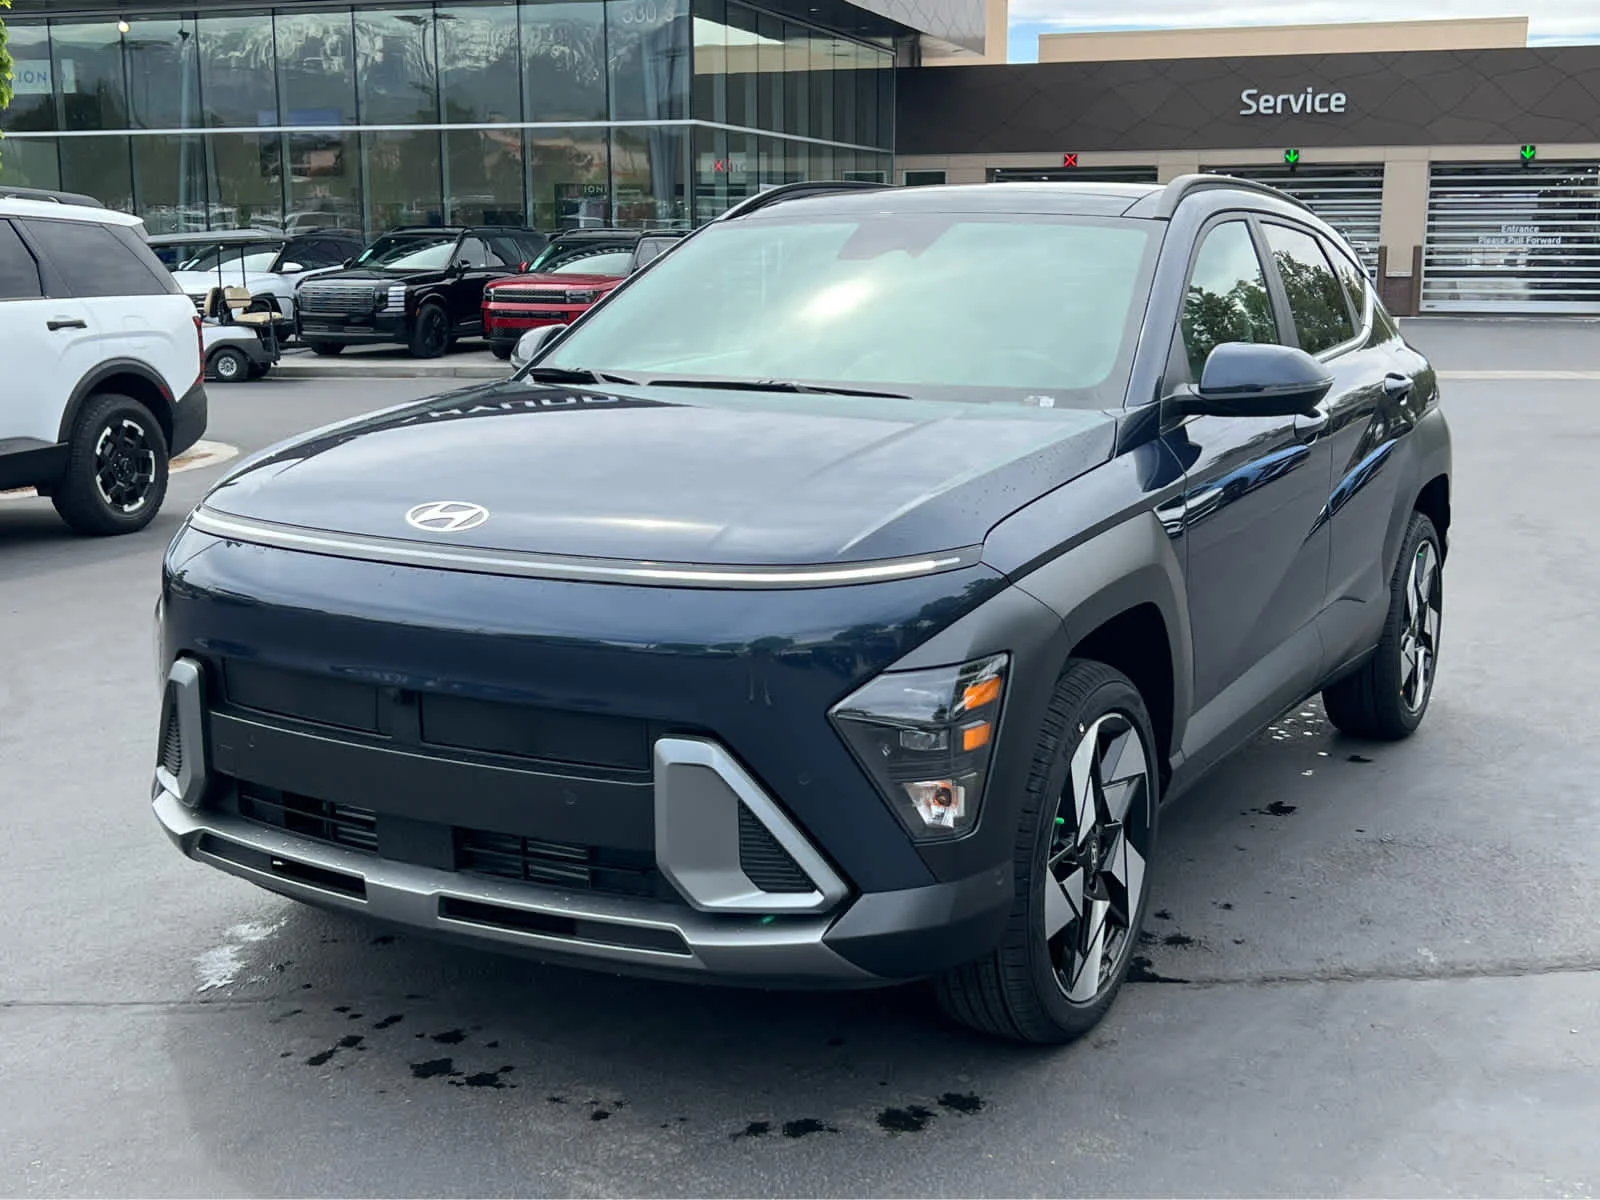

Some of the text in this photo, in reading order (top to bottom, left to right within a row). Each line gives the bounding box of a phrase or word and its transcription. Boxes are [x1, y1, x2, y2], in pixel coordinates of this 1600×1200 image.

[1239, 87, 1347, 116] Service
[1501, 224, 1540, 233] Entrance
[1478, 235, 1562, 245] Please Pull Forward
